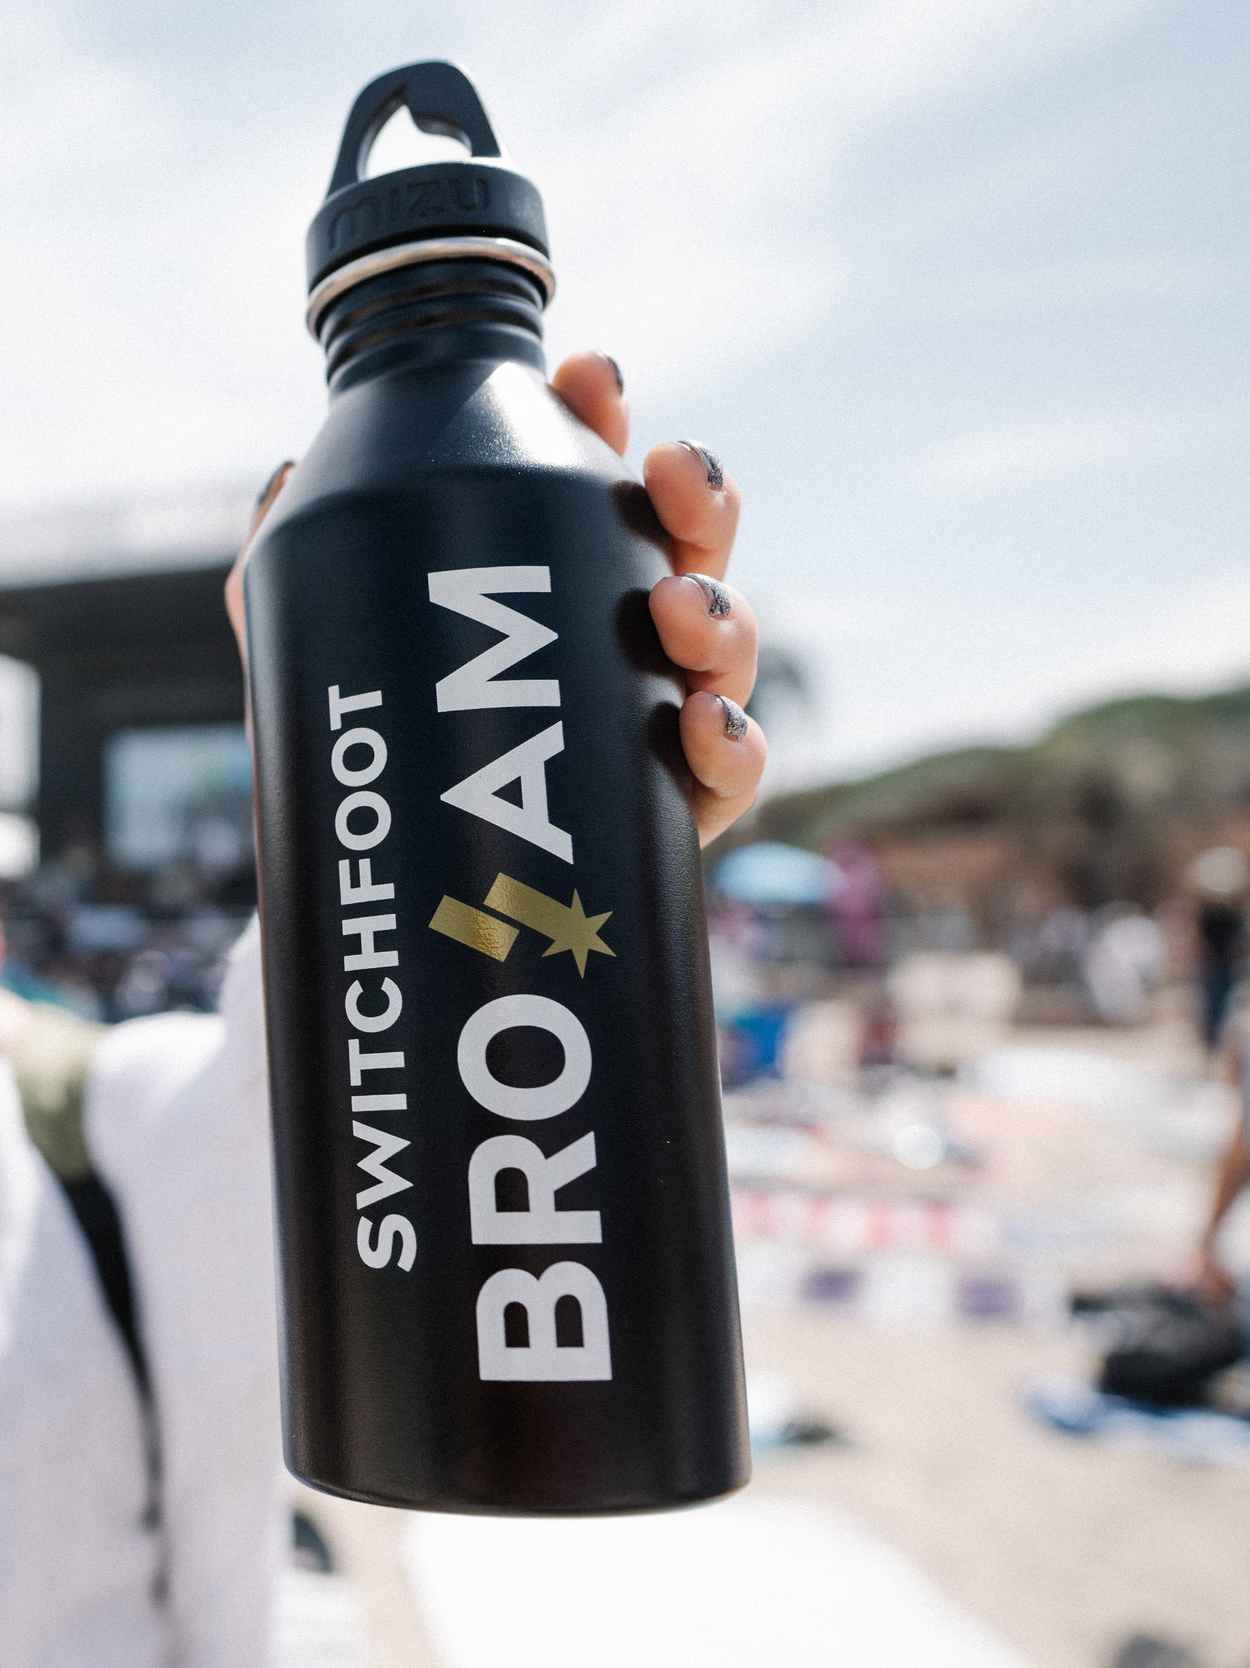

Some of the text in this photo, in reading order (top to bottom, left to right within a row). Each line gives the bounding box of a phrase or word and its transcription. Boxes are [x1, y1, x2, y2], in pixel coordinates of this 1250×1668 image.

[328, 685, 417, 1272] SWITCHFOOT
[428, 565, 612, 1381] BRO AM
